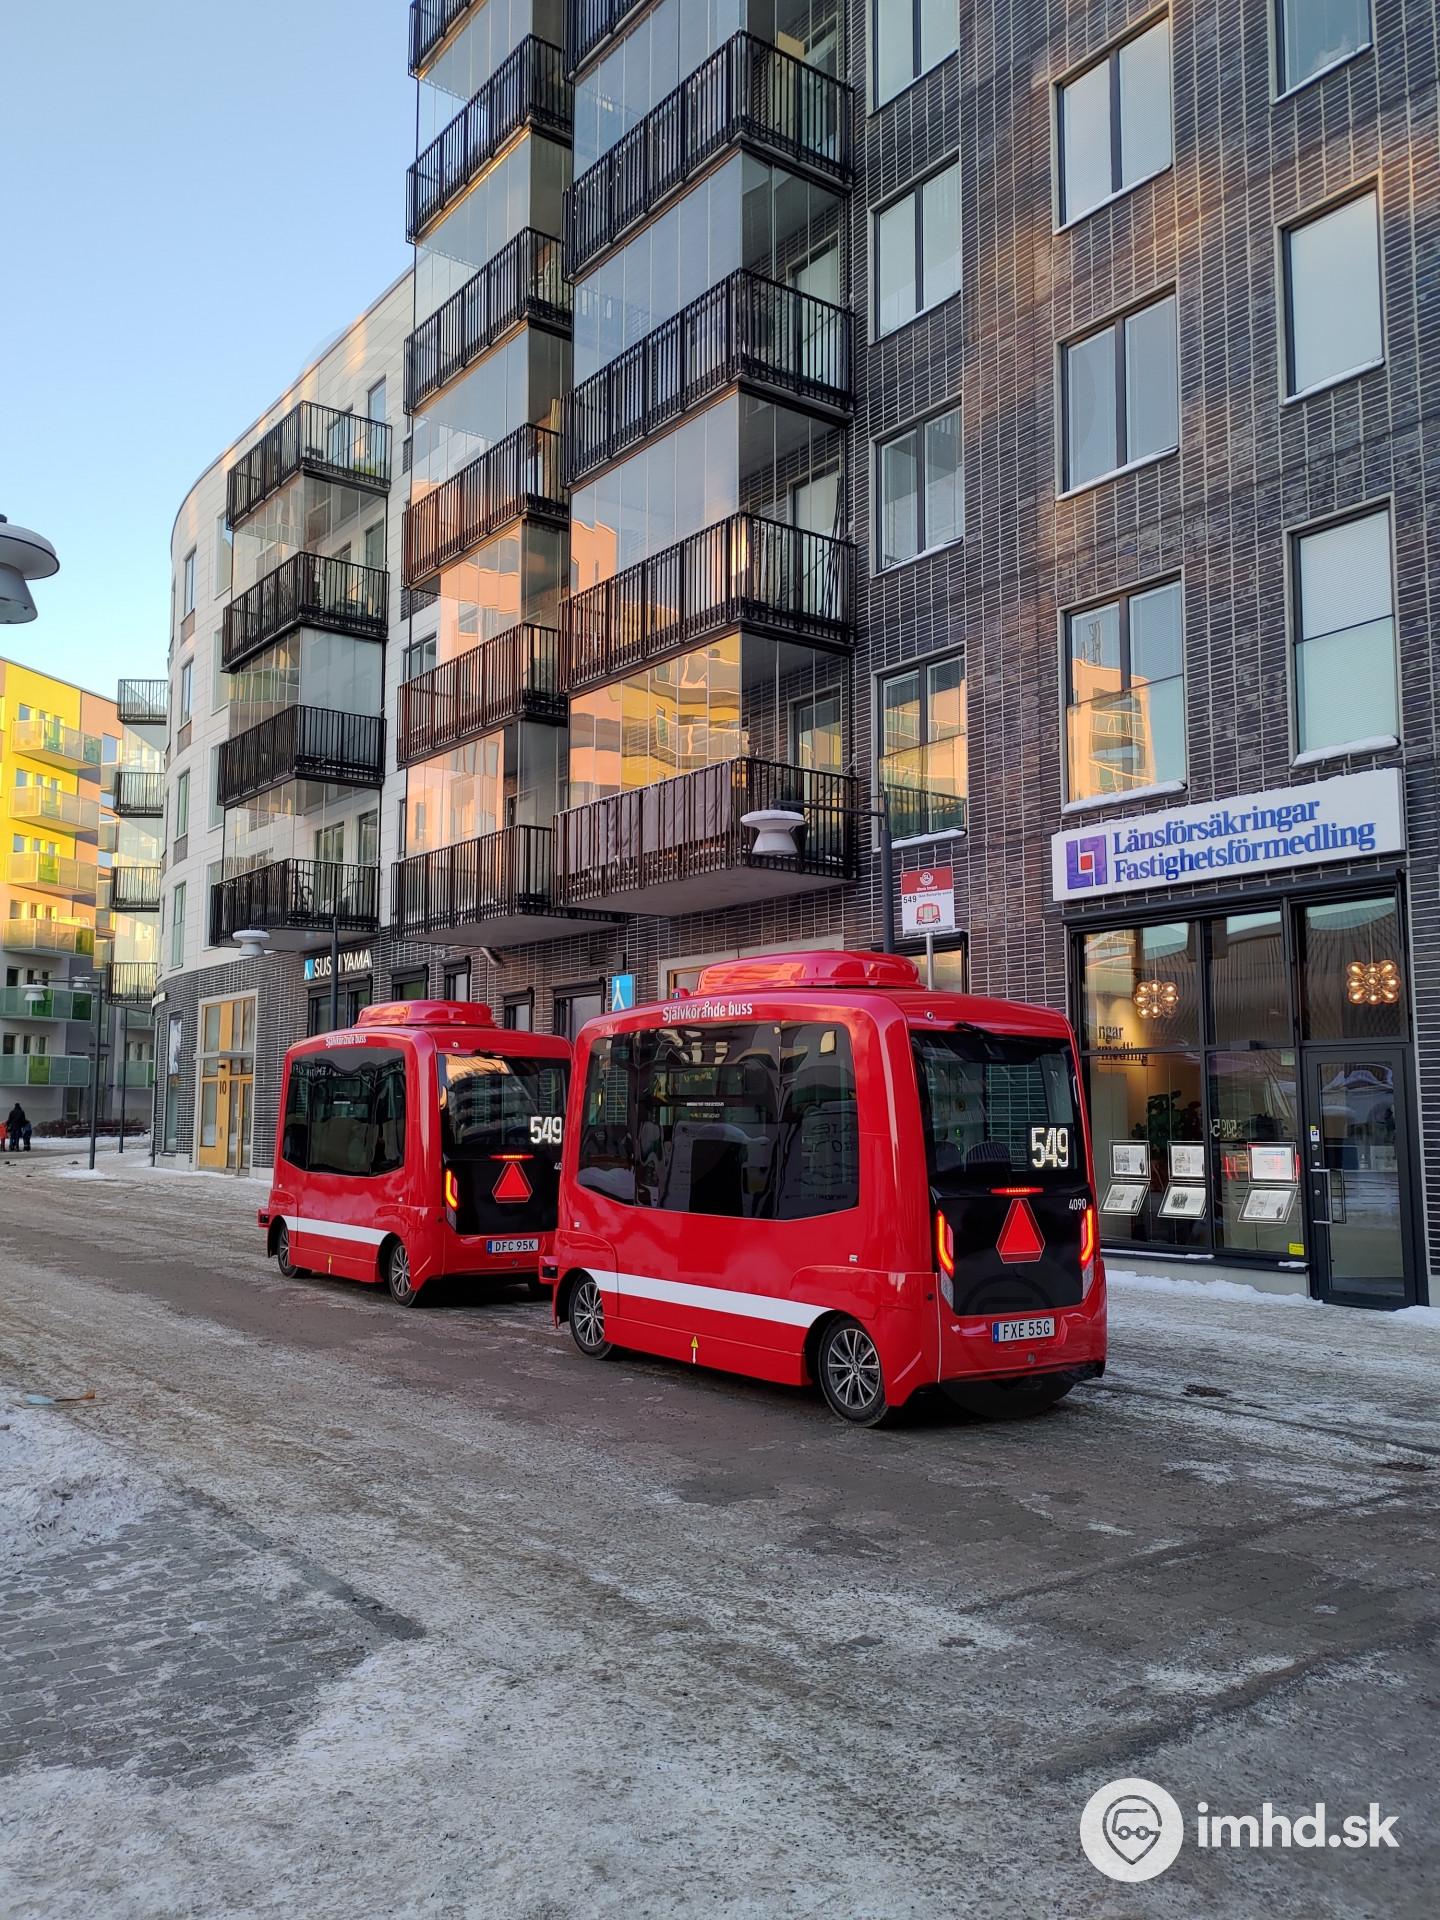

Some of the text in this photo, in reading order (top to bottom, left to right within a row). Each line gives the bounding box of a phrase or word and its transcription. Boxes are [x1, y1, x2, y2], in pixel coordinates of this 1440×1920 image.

[1113, 800, 1321, 855] Länsförsäkringar
[1114, 822, 1377, 883] Fastighetsförmedling
[903, 895, 917, 903] 549
[314, 949, 372, 978] SUSI YAMA
[728, 1001, 753, 1016] buss
[219, 1080, 227, 1095] 10
[530, 1116, 563, 1144] 549
[1031, 1127, 1069, 1168] 549
[1069, 1198, 1087, 1210] 4090
[495, 1240, 535, 1251] DFC 95K
[1003, 1320, 1050, 1340] FXE 55G
